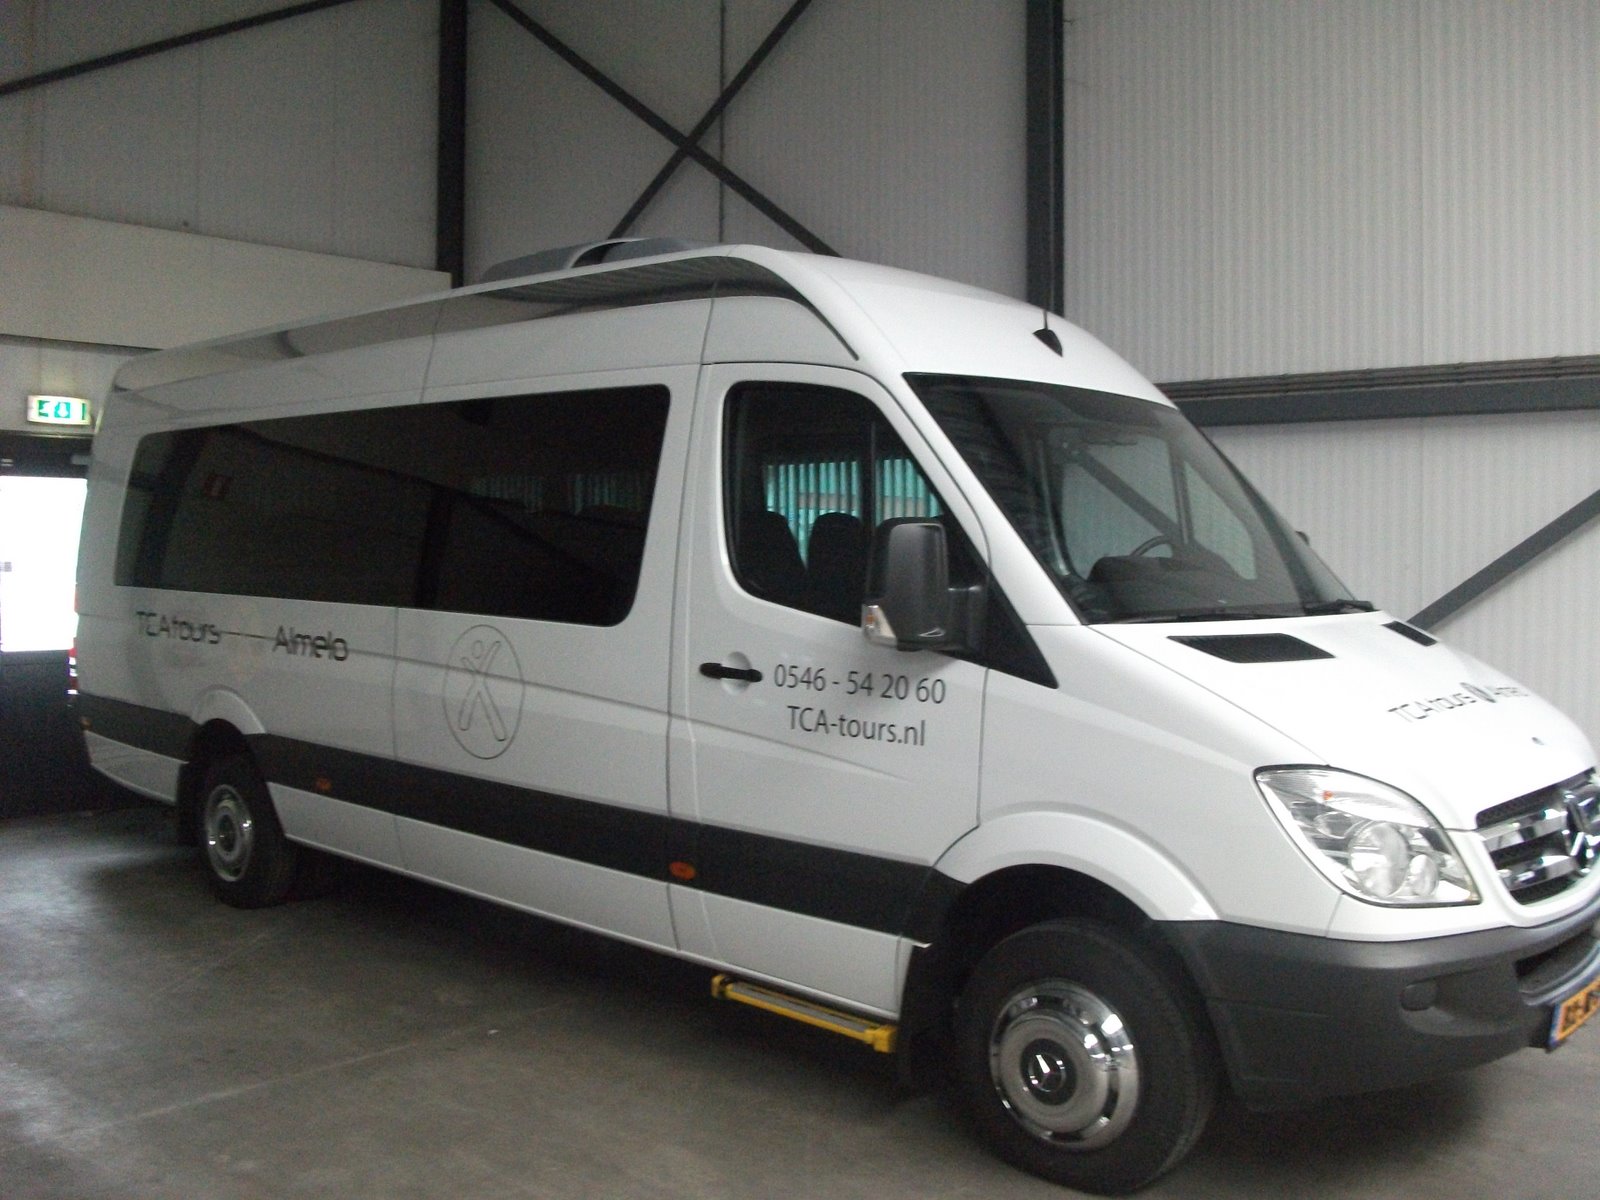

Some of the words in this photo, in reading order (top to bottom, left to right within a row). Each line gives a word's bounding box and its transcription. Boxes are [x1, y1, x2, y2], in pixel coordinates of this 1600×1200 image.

[273, 625, 348, 661] Almelo
[774, 664, 826, 691] 0546
[846, 671, 874, 697] 54
[880, 674, 909, 700] 20
[916, 678, 946, 704] 60
[787, 705, 926, 746] TCA-tours.nl
